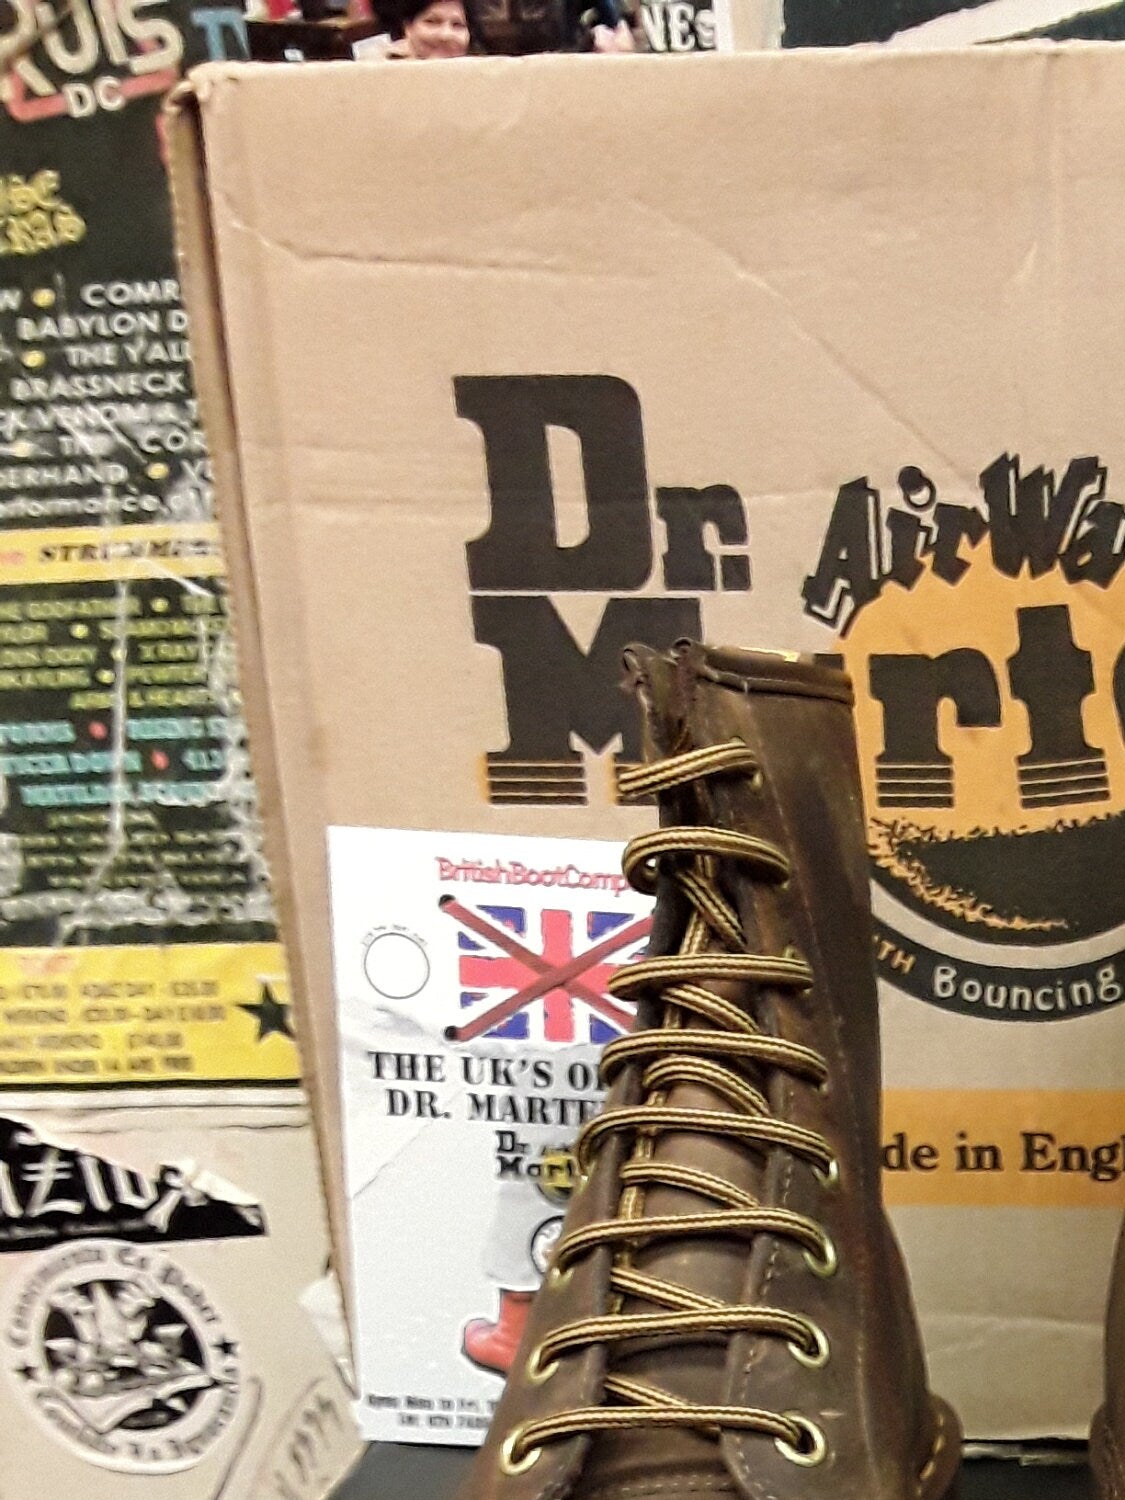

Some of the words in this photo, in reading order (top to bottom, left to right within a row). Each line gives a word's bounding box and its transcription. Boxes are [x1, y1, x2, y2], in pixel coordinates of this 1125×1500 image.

[932, 963, 1123, 1012] Bouncing
[367, 1050, 446, 1083] THE
[461, 1055, 554, 1089] UK'S
[385, 1088, 451, 1119] DR.
[955, 1130, 1004, 1172] in
